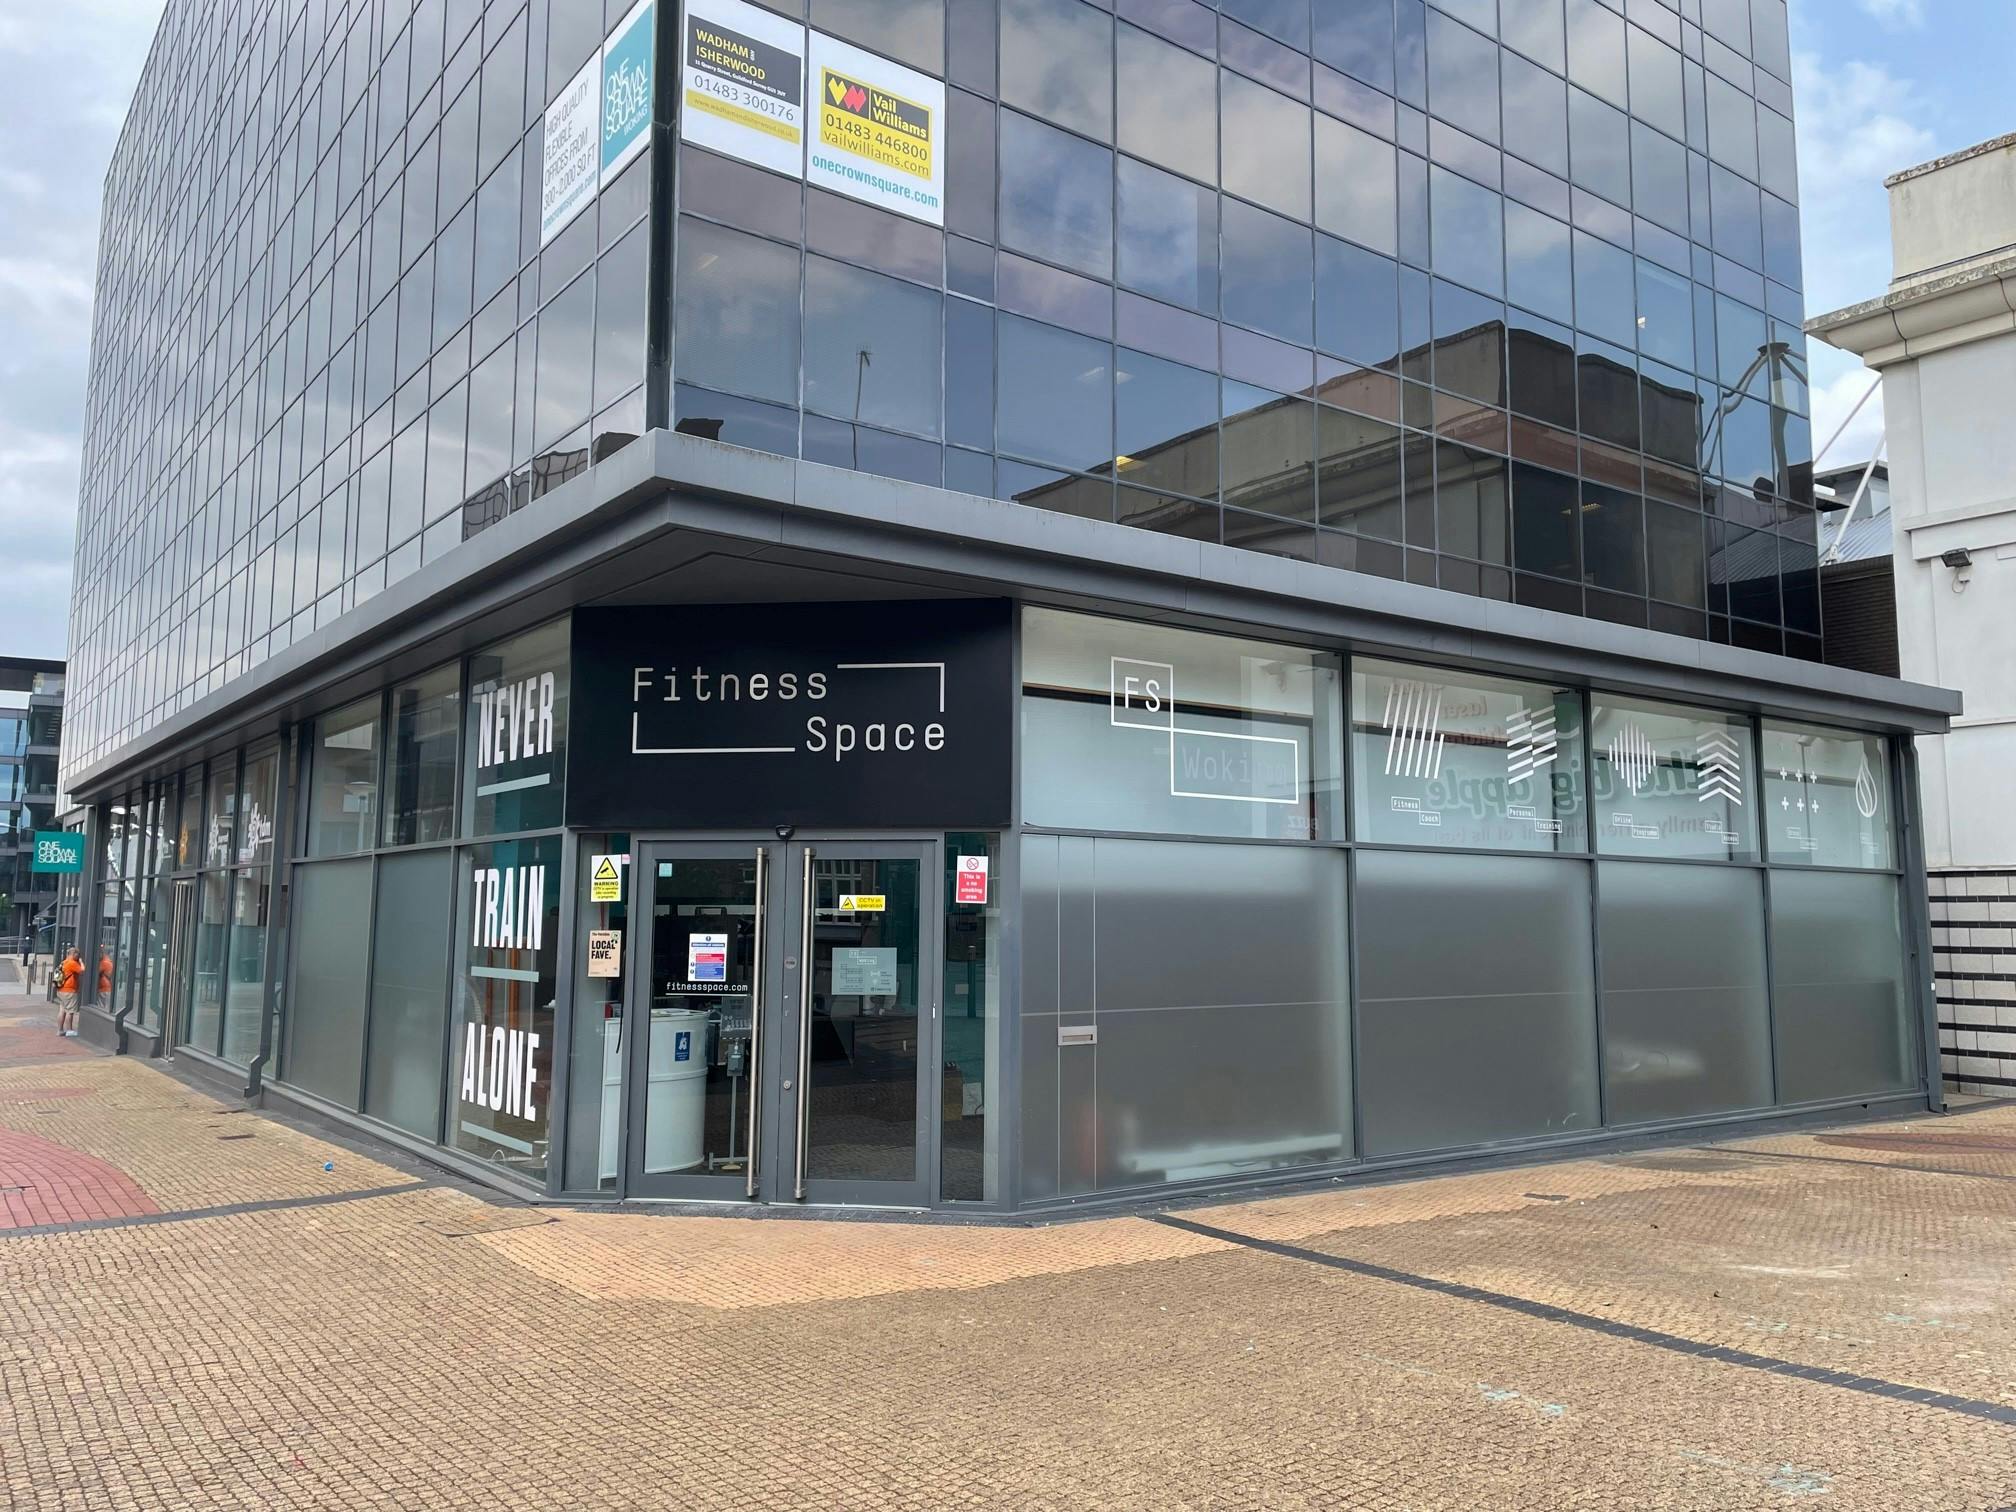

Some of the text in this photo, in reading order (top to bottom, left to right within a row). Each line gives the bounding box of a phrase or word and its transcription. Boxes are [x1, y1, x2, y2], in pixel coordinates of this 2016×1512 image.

[696, 28, 749, 59] WADHAM
[607, 57, 630, 98] ONE
[696, 45, 766, 80] ISHERWOOD
[606, 59, 646, 119] CROWN
[694, 74, 794, 121] 01483 300176
[873, 93, 897, 113] Vail
[546, 80, 590, 140] HIGH QUALITY
[606, 78, 648, 140] SQUARE
[873, 107, 927, 139] Williams
[545, 120, 573, 163] FLEXIBLE
[824, 131, 930, 177] vailwilliams.com
[826, 113, 928, 161] 01483 446800
[545, 127, 588, 188] OFFICES FROM
[812, 155, 938, 208] onecrownsquare.com
[633, 665, 828, 702] Fitness
[1124, 676, 1161, 713] FS
[477, 671, 555, 769] NEVER
[806, 715, 945, 762] Space
[1182, 745, 1288, 792] Woki
[1393, 799, 1419, 809] Fitness
[1421, 814, 1439, 823] Coach
[1509, 807, 1534, 817] Personal
[38, 840, 61, 849] ONE
[1536, 821, 1561, 831] Training
[38, 847, 76, 857] CROWN
[38, 855, 77, 864] SQUARE
[473, 865, 545, 951] TRAIN
[591, 940, 616, 950] LOCAL
[591, 950, 612, 960] FAVE.
[666, 981, 748, 992] fitnessspace.com
[461, 1022, 540, 1122] ALONE
